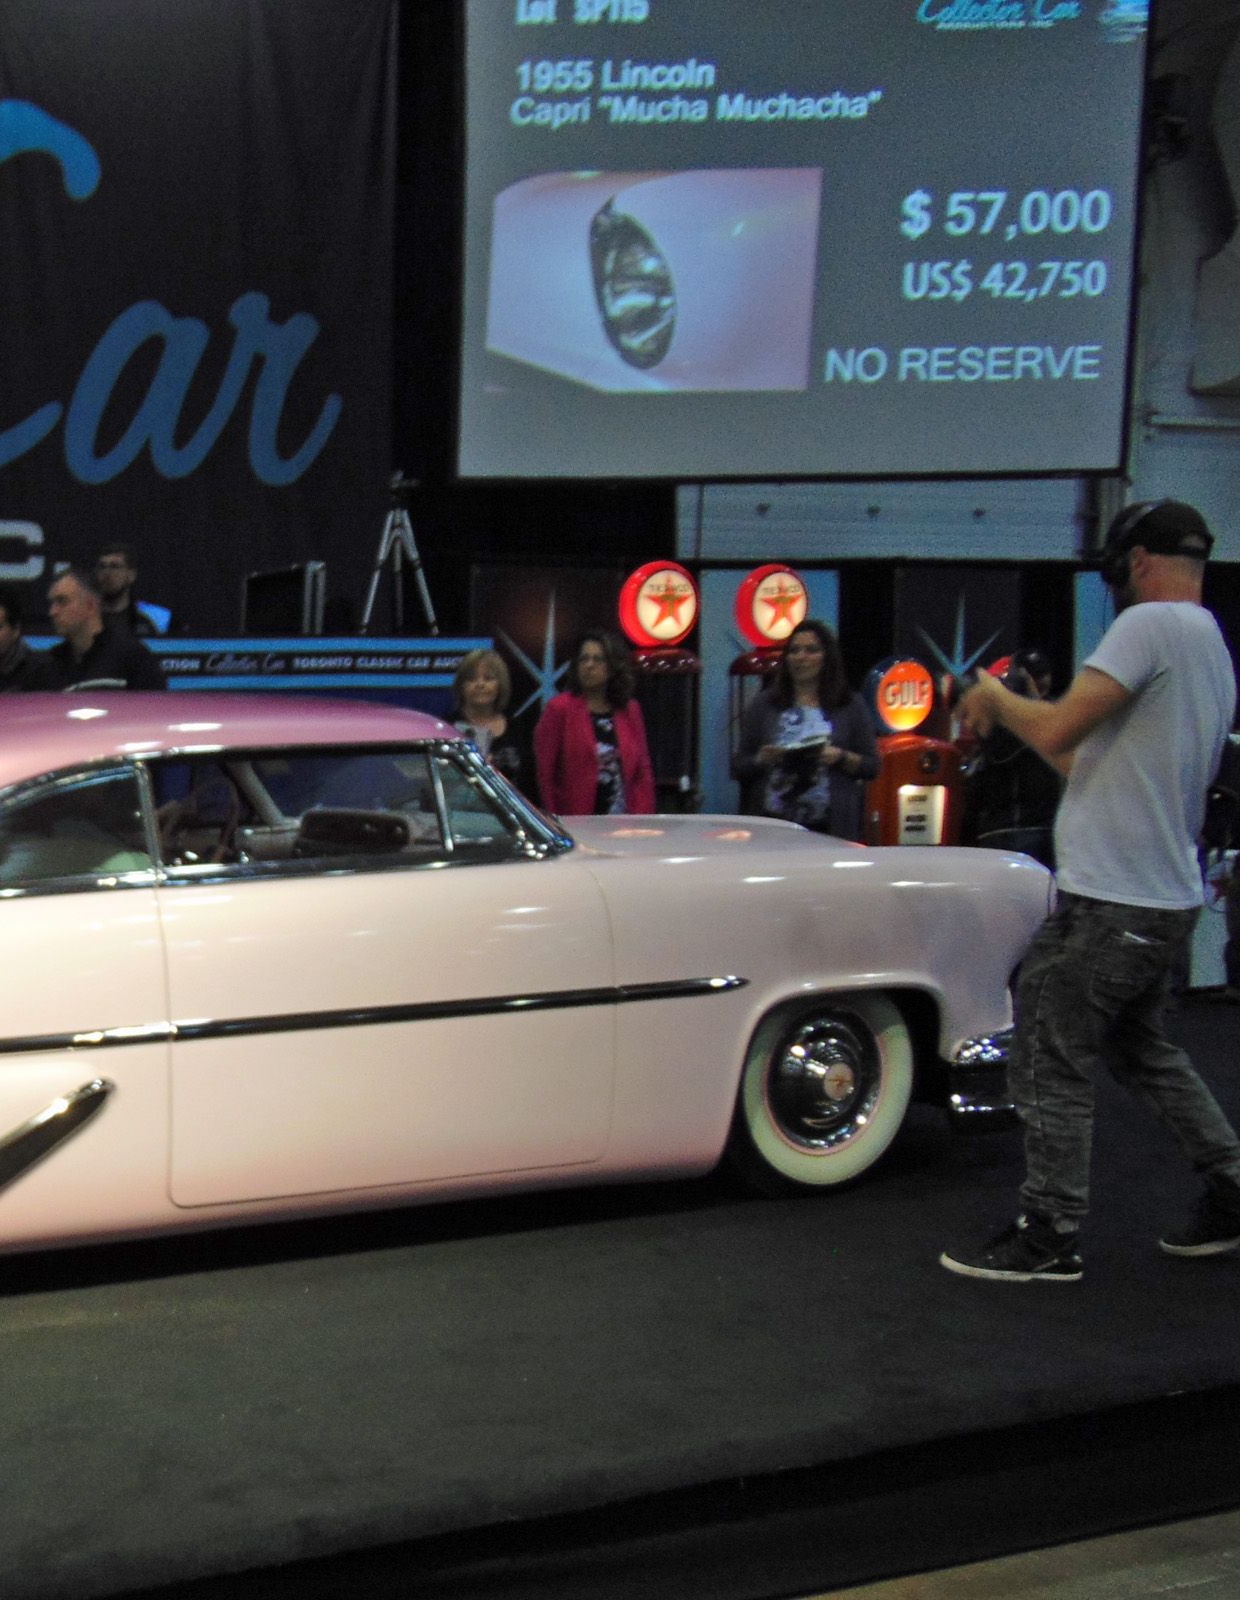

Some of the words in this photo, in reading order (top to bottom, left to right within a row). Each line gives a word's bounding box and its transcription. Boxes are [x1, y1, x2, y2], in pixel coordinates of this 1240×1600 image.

[515, 0, 558, 24] Lot
[516, 59, 594, 91] 1955
[601, 58, 716, 89] Lincoln
[511, 96, 591, 129] Capri
[598, 95, 709, 124] "Mucha
[716, 90, 882, 122] Muchacha"
[900, 189, 932, 240] $
[944, 188, 1112, 241] 57,000
[902, 259, 973, 303] US$
[978, 259, 1108, 303] 42,750
[824, 346, 888, 383] NO
[897, 344, 1103, 381] RESERVE
[884, 680, 929, 707] GULF
